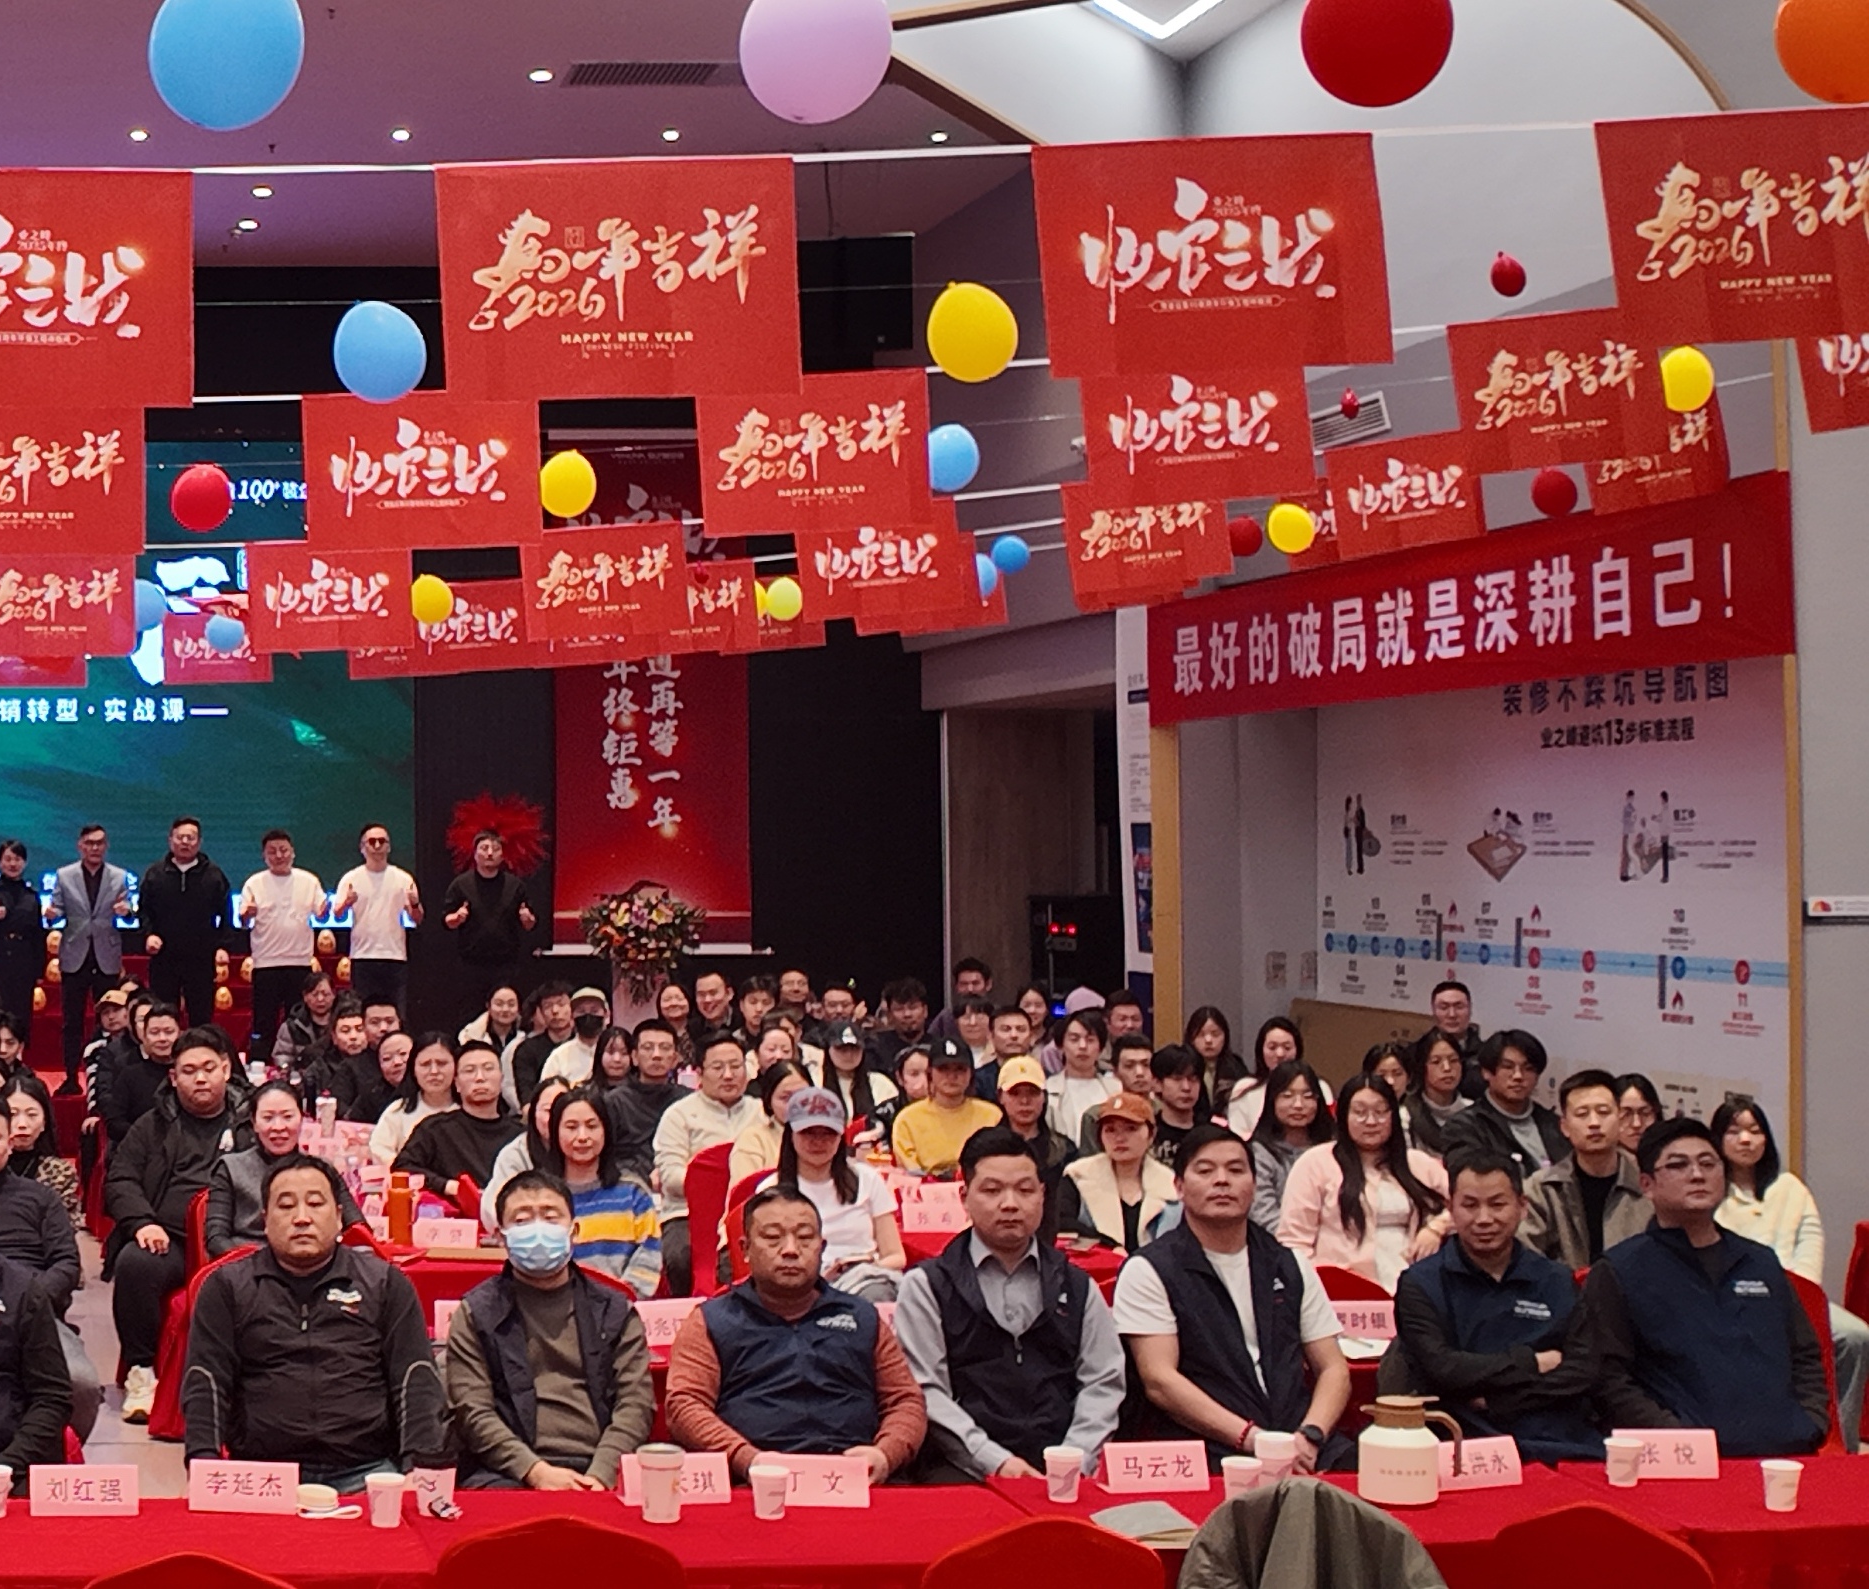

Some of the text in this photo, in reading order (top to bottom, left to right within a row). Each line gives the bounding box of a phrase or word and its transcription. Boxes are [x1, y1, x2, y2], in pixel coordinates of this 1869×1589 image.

[560, 330, 695, 345] HAPPY NEW YEAR
[1121, 1454, 1195, 1481] 马云龙
[44, 1478, 125, 1504] 刘红强
[204, 1471, 285, 1499] 李延杰
